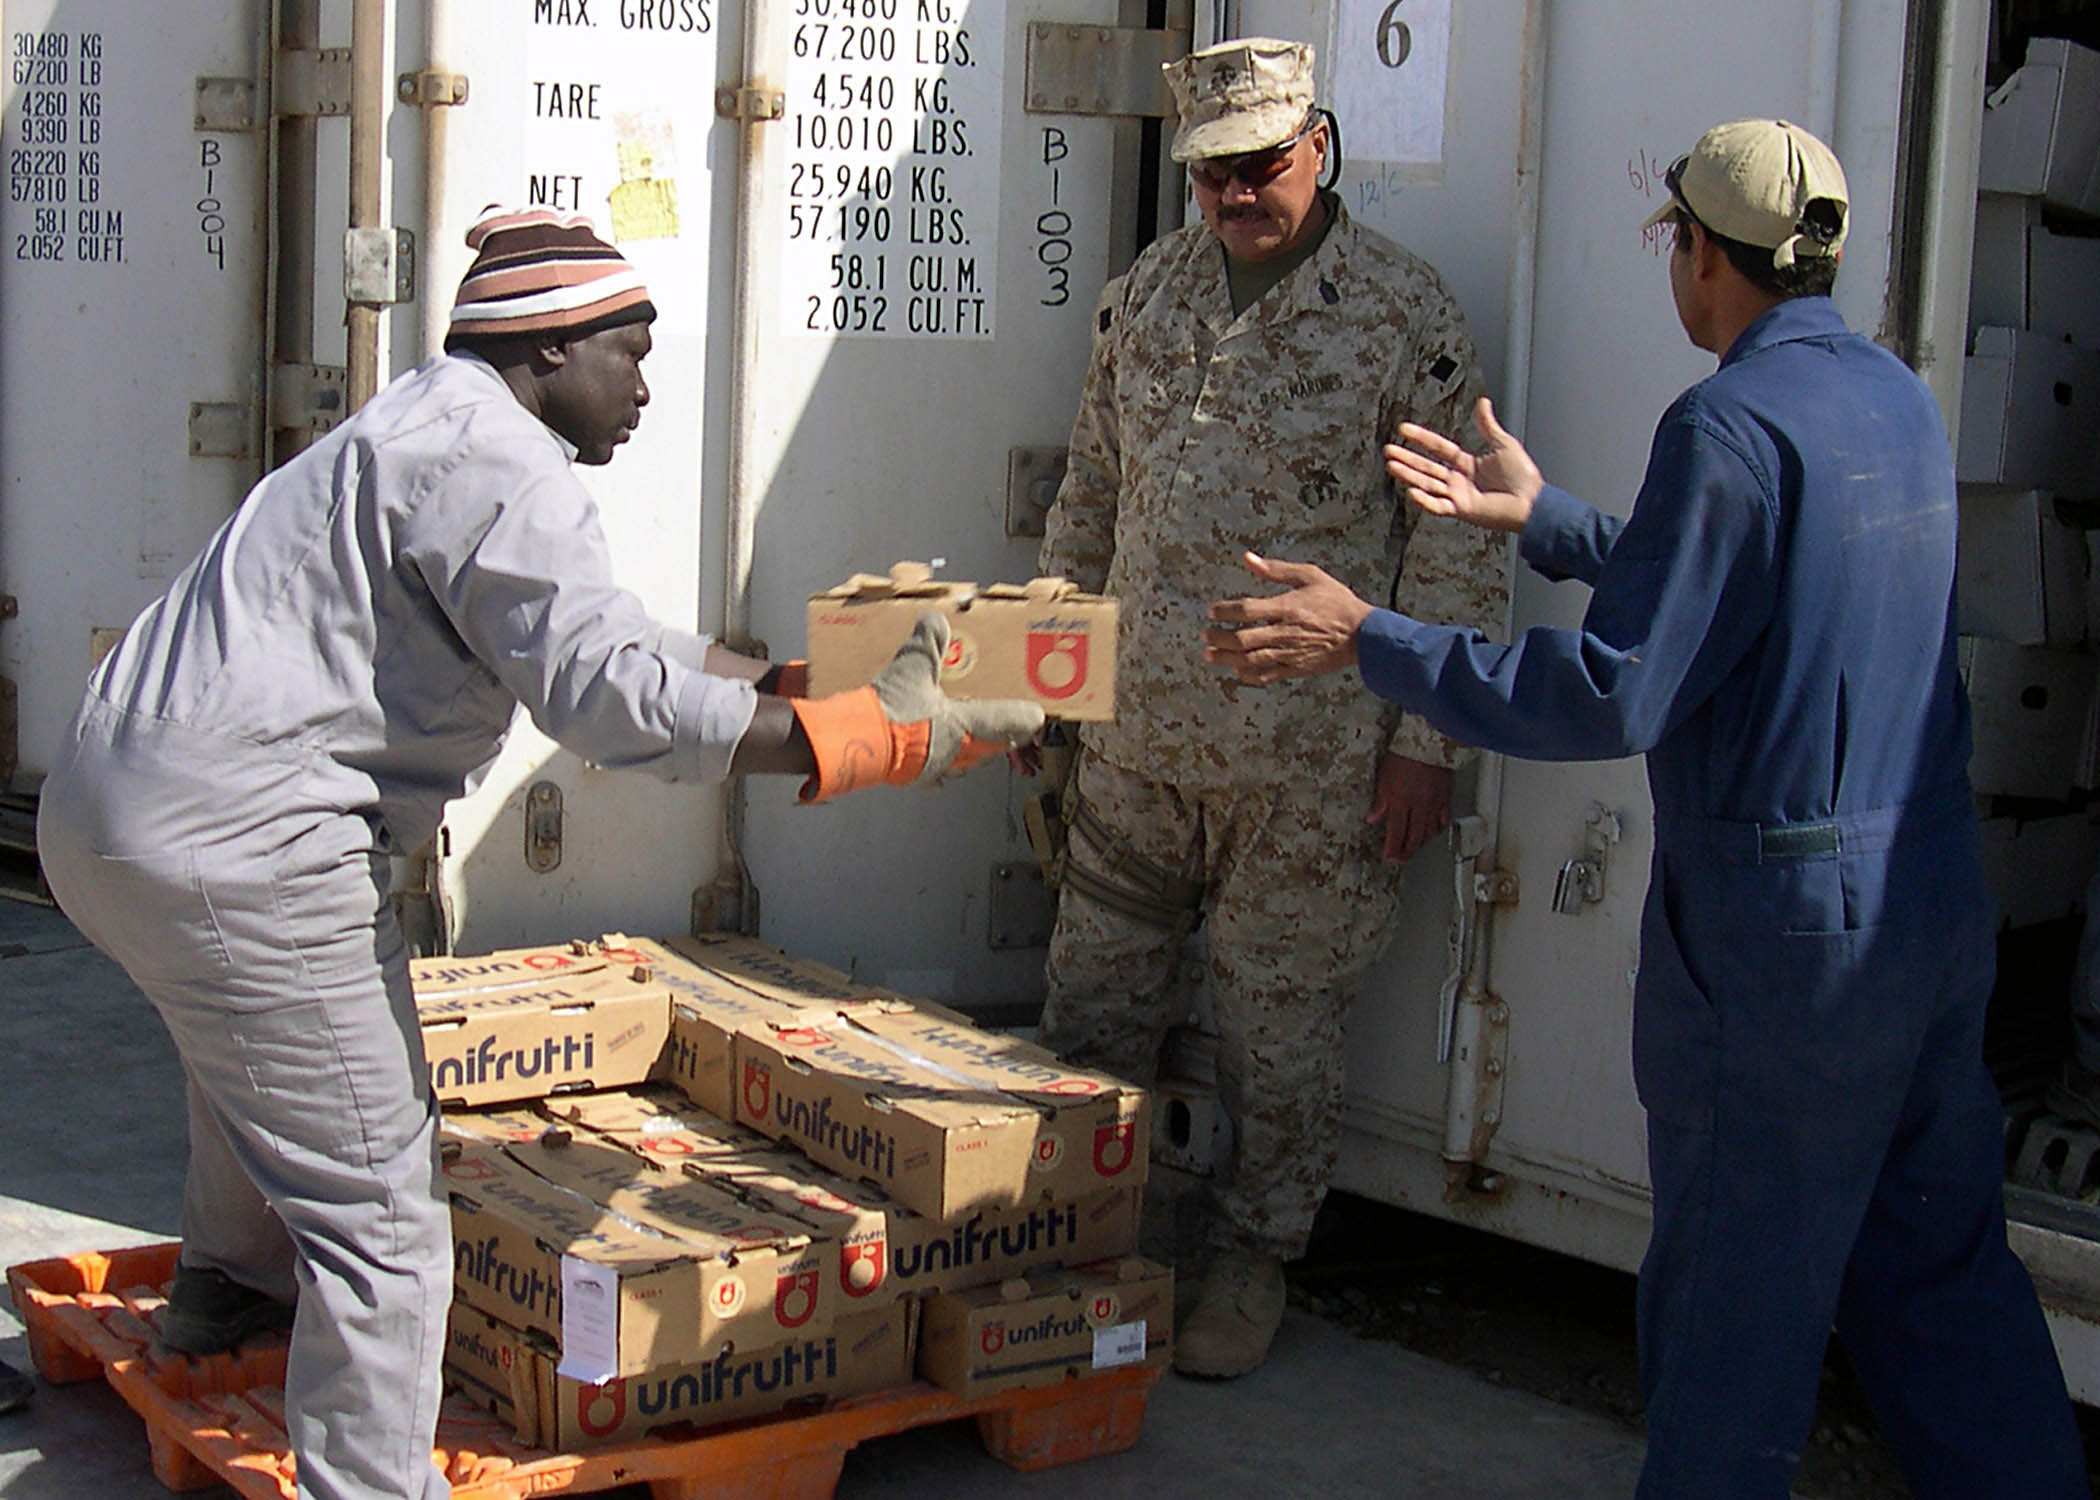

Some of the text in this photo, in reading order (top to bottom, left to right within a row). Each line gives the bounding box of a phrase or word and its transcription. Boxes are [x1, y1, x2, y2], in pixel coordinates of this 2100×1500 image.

[534, 0, 711, 33] MAX. GROSS
[1376, 0, 1412, 69] 6
[80, 33, 103, 59] KG
[793, 23, 976, 67] 67,200 LBS.
[80, 60, 102, 86] LB
[79, 92, 101, 118] KG
[533, 81, 601, 120] TARE
[813, 72, 955, 114] 4,540 KG.
[79, 118, 101, 145] LB
[913, 118, 973, 156] LBS.
[79, 150, 100, 177] KG
[78, 177, 100, 204] LB
[529, 174, 583, 211] NET
[790, 162, 953, 204] 25,940 KG.
[35, 208, 66, 235] 58.1
[789, 204, 970, 246] 57,190 LBS.
[831, 254, 885, 291] 58.1
[806, 295, 887, 332] 2,052
[429, 1032, 594, 1089] nifrutti
[775, 1090, 895, 1178] unifrutti
[895, 1205, 1077, 1279] unifrutti
[454, 1235, 562, 1324] nifrutt
[1008, 1313, 1092, 1346] unifrut
[637, 1337, 837, 1416] unifrutti
